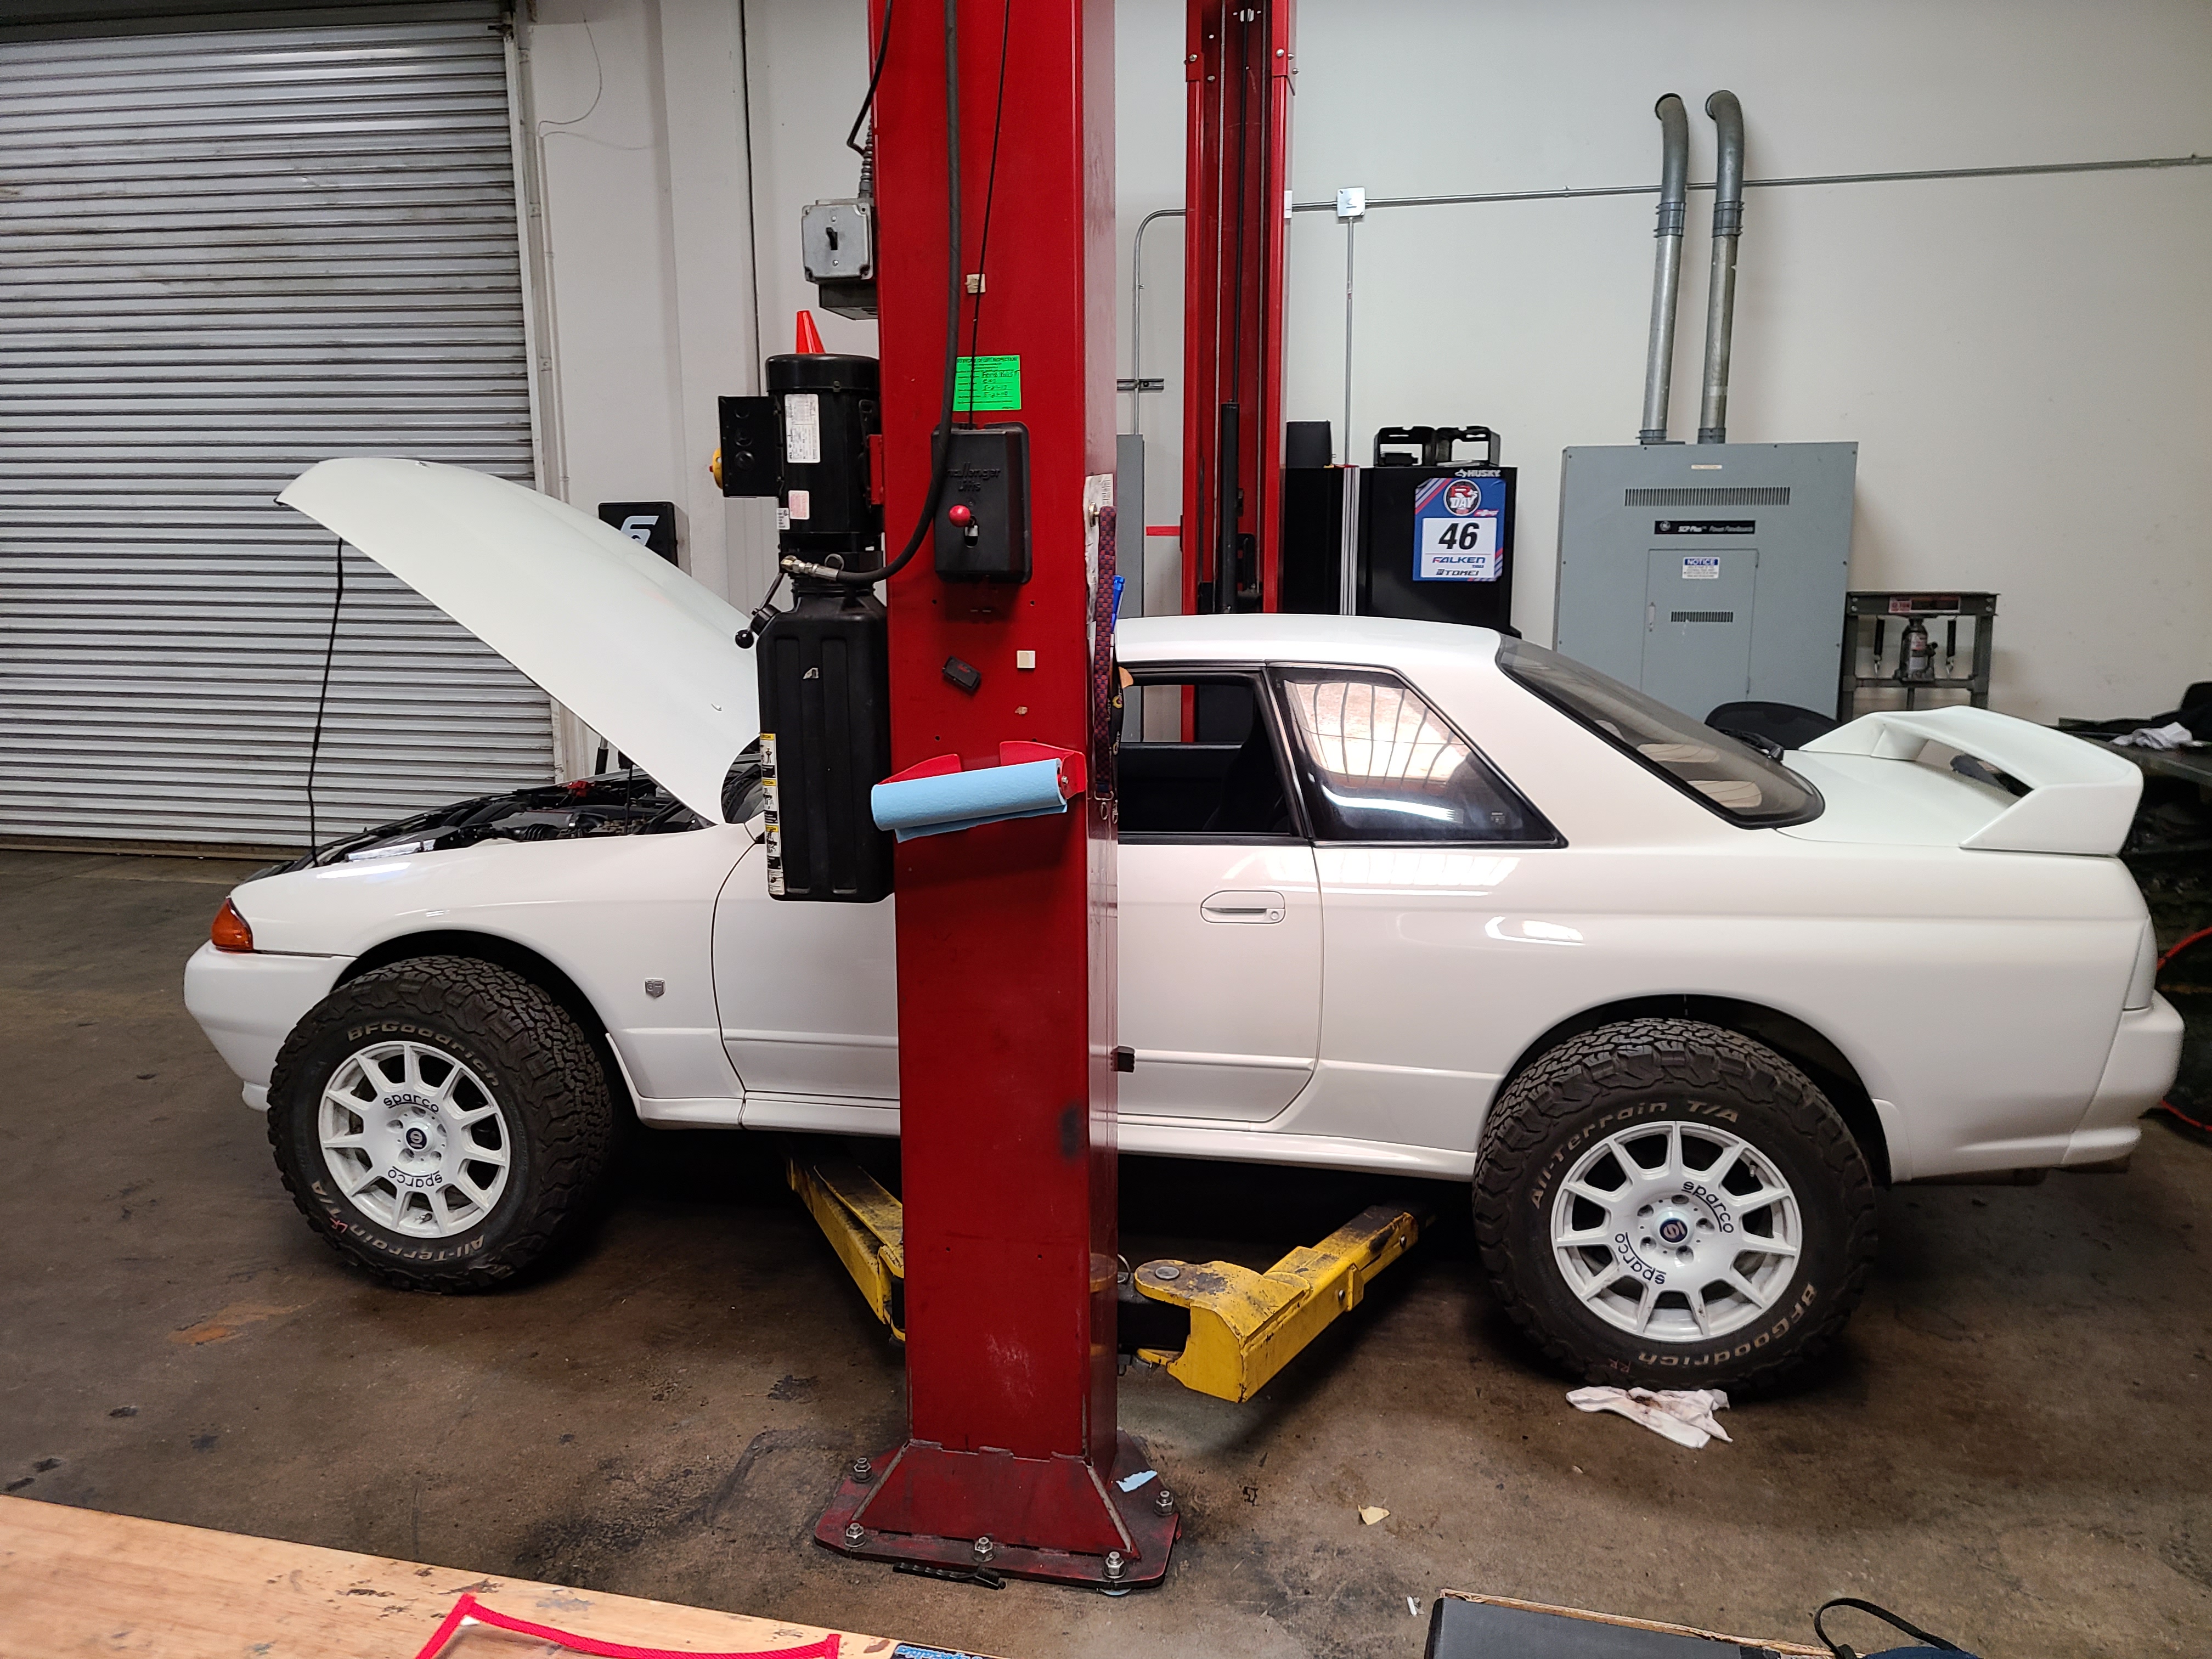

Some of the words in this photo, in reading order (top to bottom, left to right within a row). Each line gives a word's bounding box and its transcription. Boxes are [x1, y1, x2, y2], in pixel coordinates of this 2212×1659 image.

[947, 462, 1001, 481] allenger
[1450, 497, 1474, 509] DAY
[1438, 522, 1480, 550] 46
[347, 1020, 499, 1086] BFGoodrich
[383, 1093, 439, 1113] sparco
[1531, 1102, 1667, 1210] All-Terrain
[1687, 1099, 1739, 1123] T/A
[388, 1169, 443, 1188] sparco
[1682, 1181, 1734, 1233] sparco
[349, 1224, 485, 1262] All-Terrain
[1615, 1233, 1666, 1285] sparco
[1638, 1282, 1818, 1365] BFGoodrich
